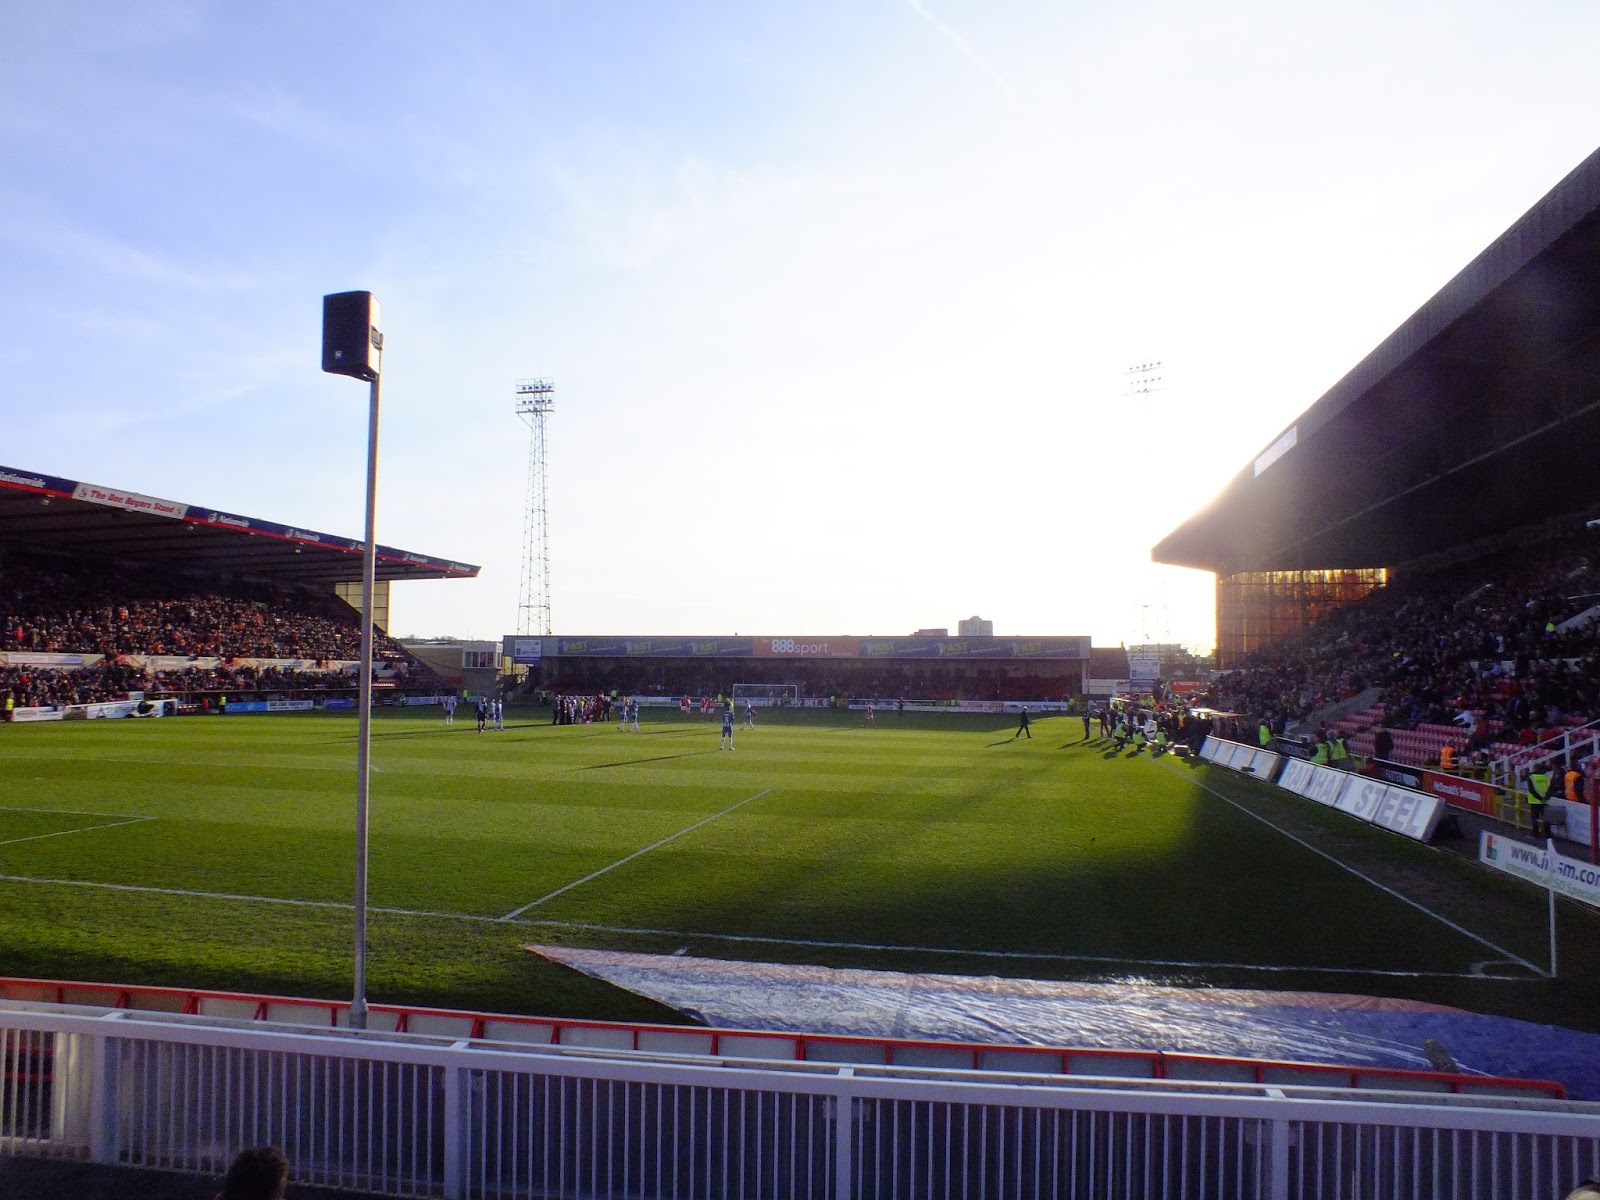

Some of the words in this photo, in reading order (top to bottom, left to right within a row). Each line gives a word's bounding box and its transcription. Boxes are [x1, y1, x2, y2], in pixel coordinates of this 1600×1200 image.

[90, 489, 106, 500] The
[107, 493, 123, 503] Don
[125, 496, 153, 510] Rogers
[153, 502, 175, 513] Stand
[804, 699, 819, 707] BET
[1354, 783, 1423, 834] STEEL
